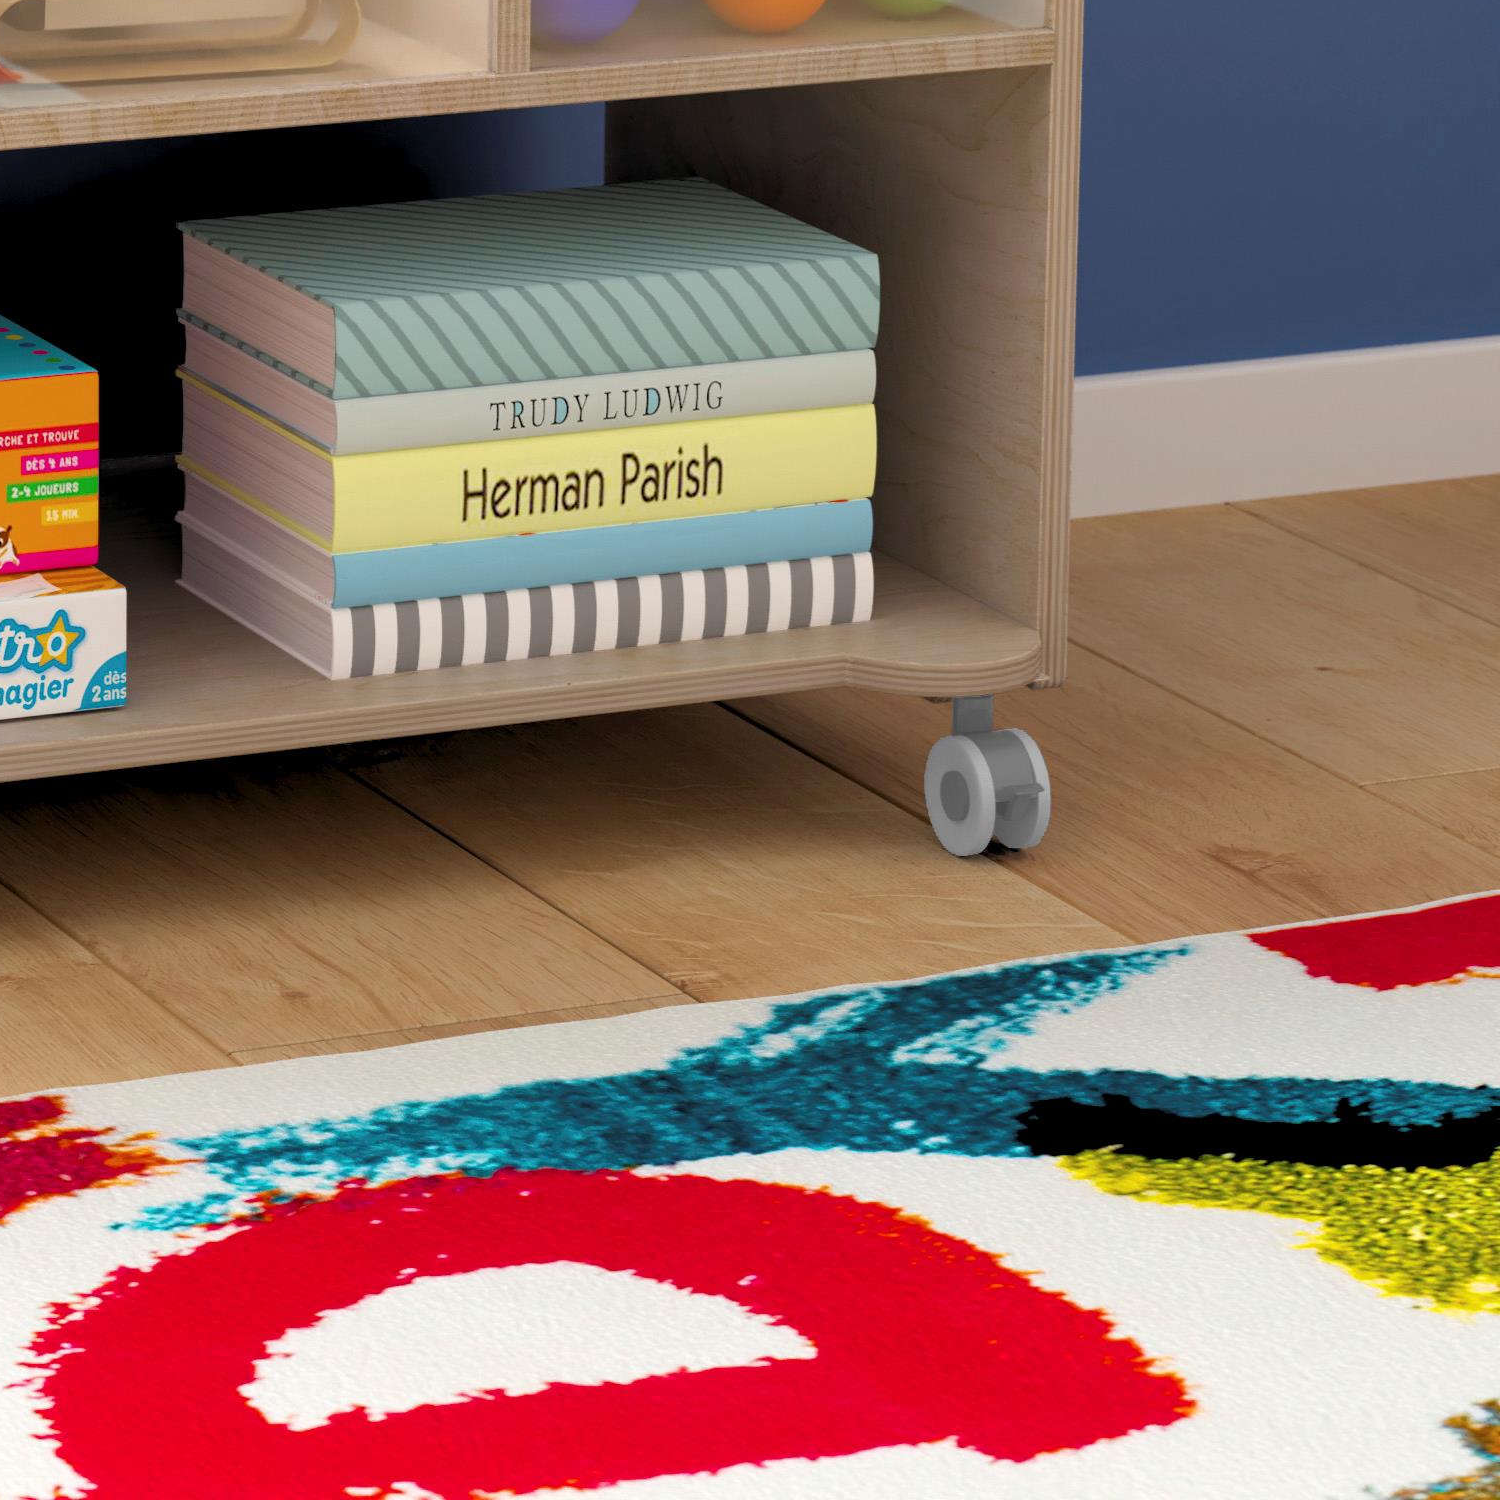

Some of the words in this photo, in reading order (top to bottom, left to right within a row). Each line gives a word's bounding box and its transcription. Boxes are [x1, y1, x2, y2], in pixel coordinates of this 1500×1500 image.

[490, 394, 590, 431] TRUDY
[603, 381, 723, 420] LUDWIG
[26, 432, 39, 445] ET
[42, 429, 80, 443] TROUVE
[48, 456, 56, 470] 4
[58, 455, 79, 468] ANS
[11, 485, 32, 499] 2-4
[34, 482, 80, 497] JOUEURS
[462, 467, 605, 522] Herman
[620, 443, 723, 505] Parish
[103, 671, 126, 685] dès
[91, 688, 101, 703] 2
[103, 686, 126, 701] ans
